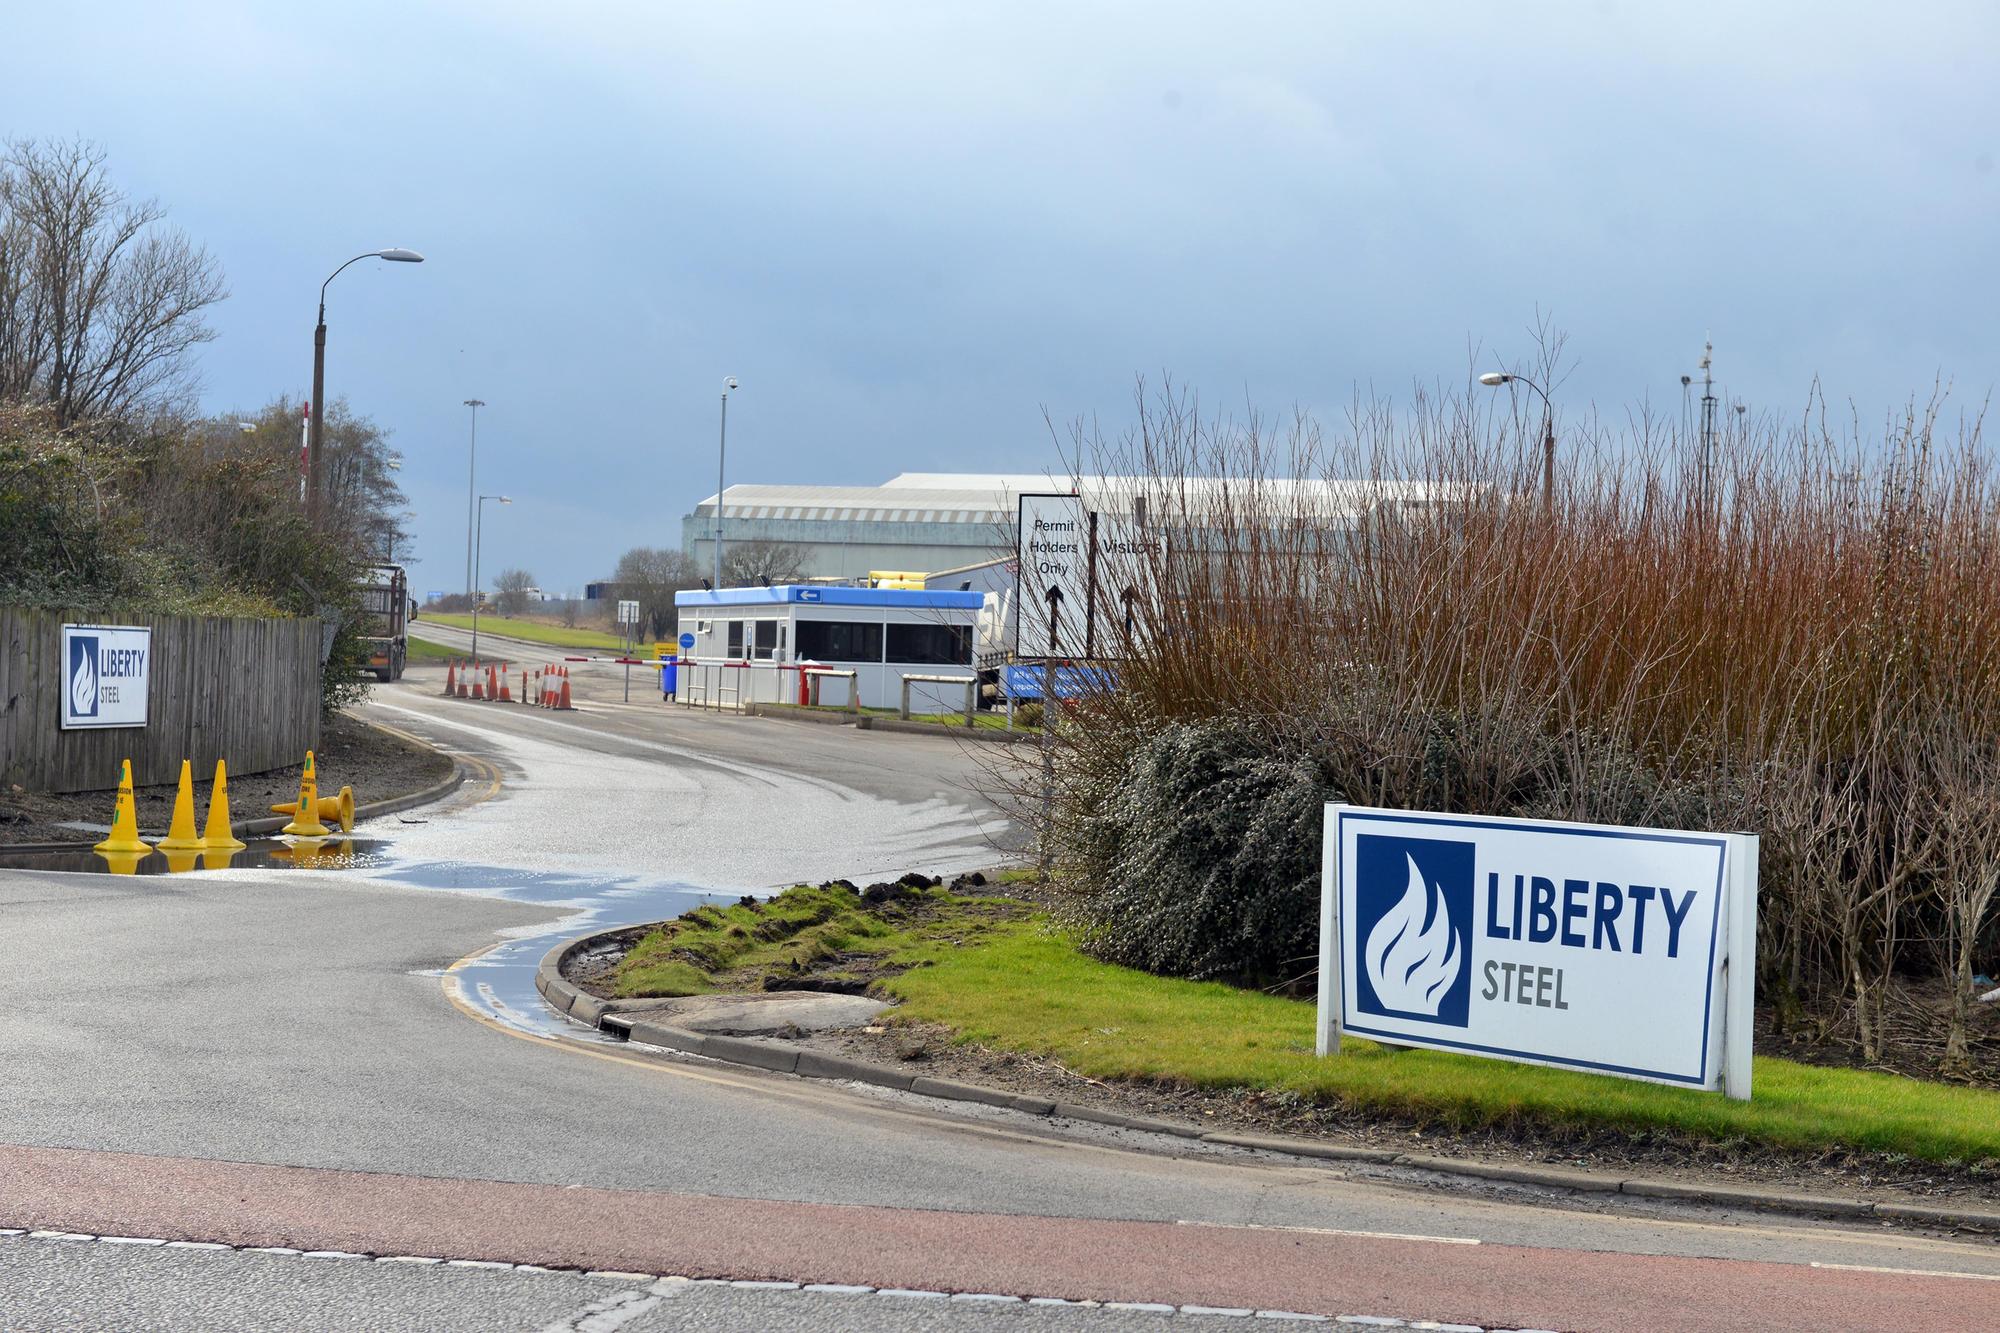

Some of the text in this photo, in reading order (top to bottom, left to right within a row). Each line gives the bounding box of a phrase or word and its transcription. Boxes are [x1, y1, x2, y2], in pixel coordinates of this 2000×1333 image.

[1034, 519, 1075, 532] Permit
[1030, 541, 1079, 553] Holders
[1104, 539, 1162, 554] Visitors
[1039, 562, 1069, 577] Only
[101, 649, 145, 677] LIBERTY
[100, 686, 120, 703] STEEL
[1486, 872, 1698, 958] LIBERTY
[1481, 959, 1568, 1010] STEEL
